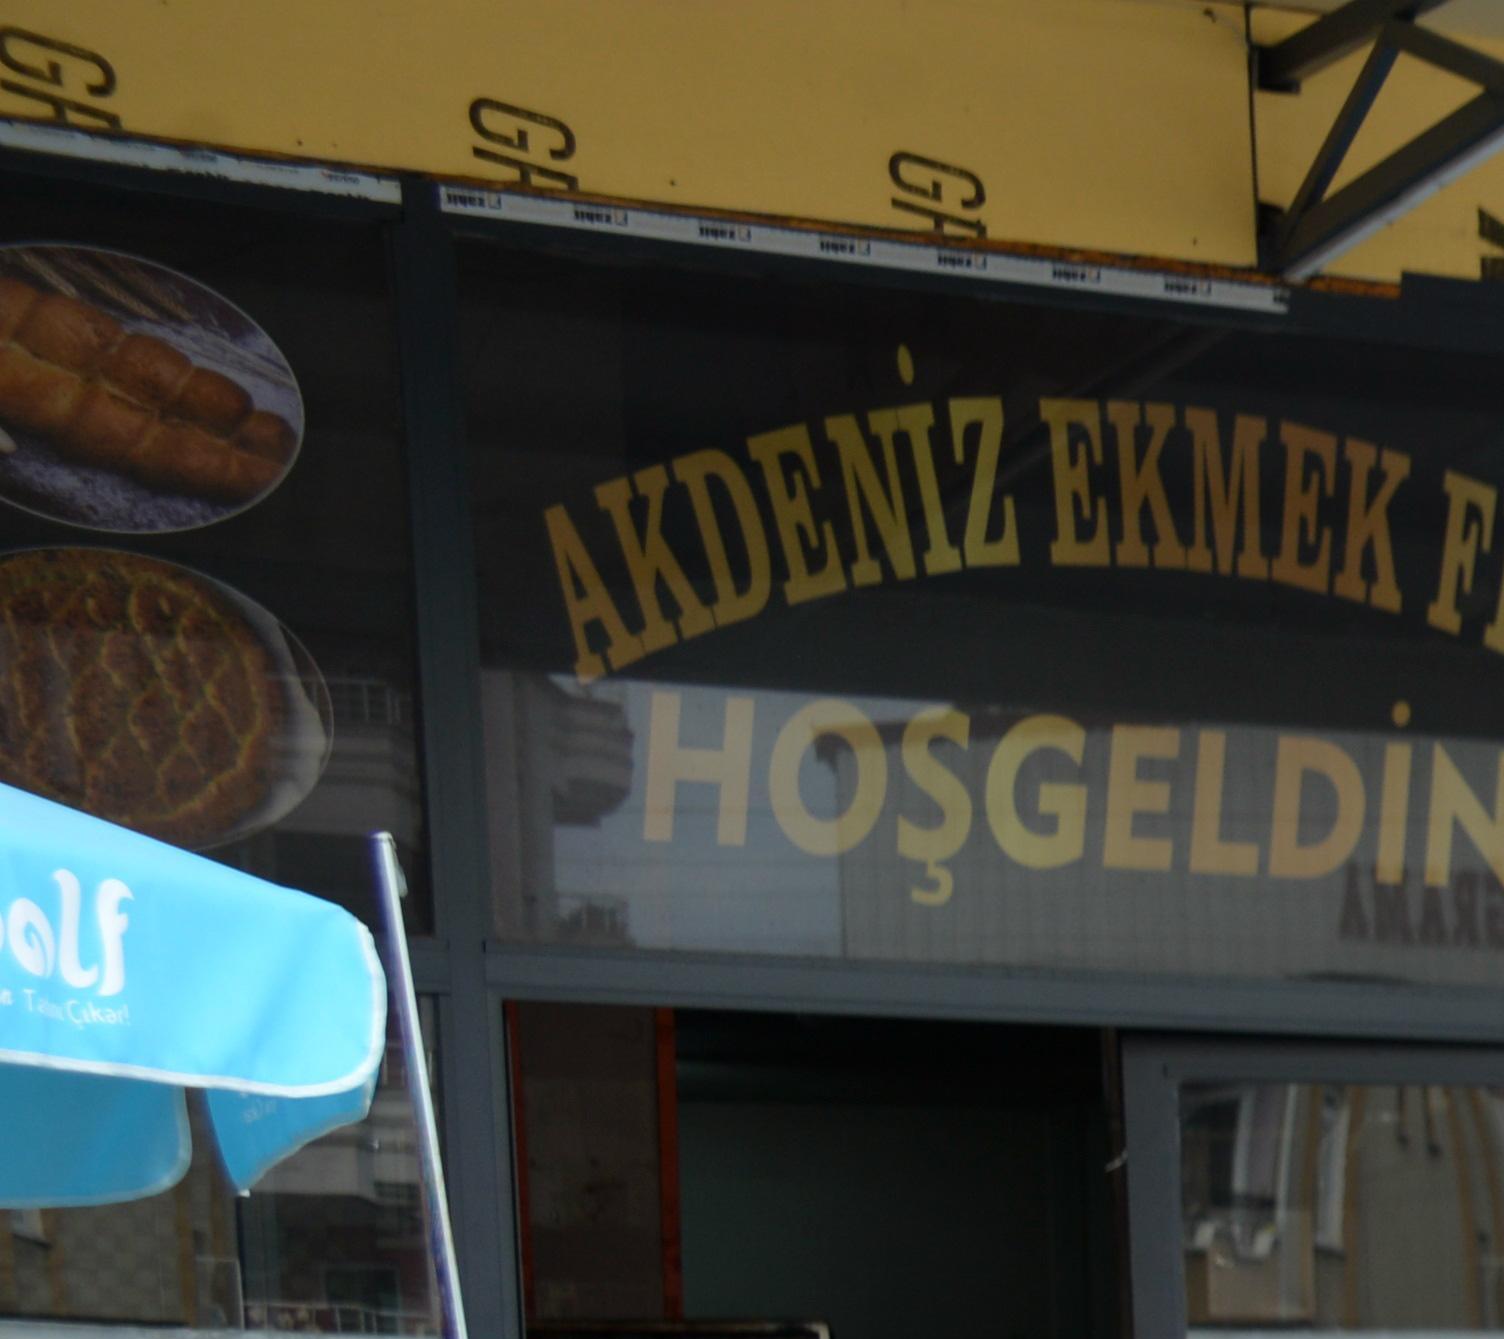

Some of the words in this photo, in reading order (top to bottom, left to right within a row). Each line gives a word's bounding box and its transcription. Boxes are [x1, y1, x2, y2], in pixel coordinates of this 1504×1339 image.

[544, 344, 1020, 683] AKDENİZ
[1039, 398, 1411, 612] EKMEK
[0, 868, 134, 997] olf
